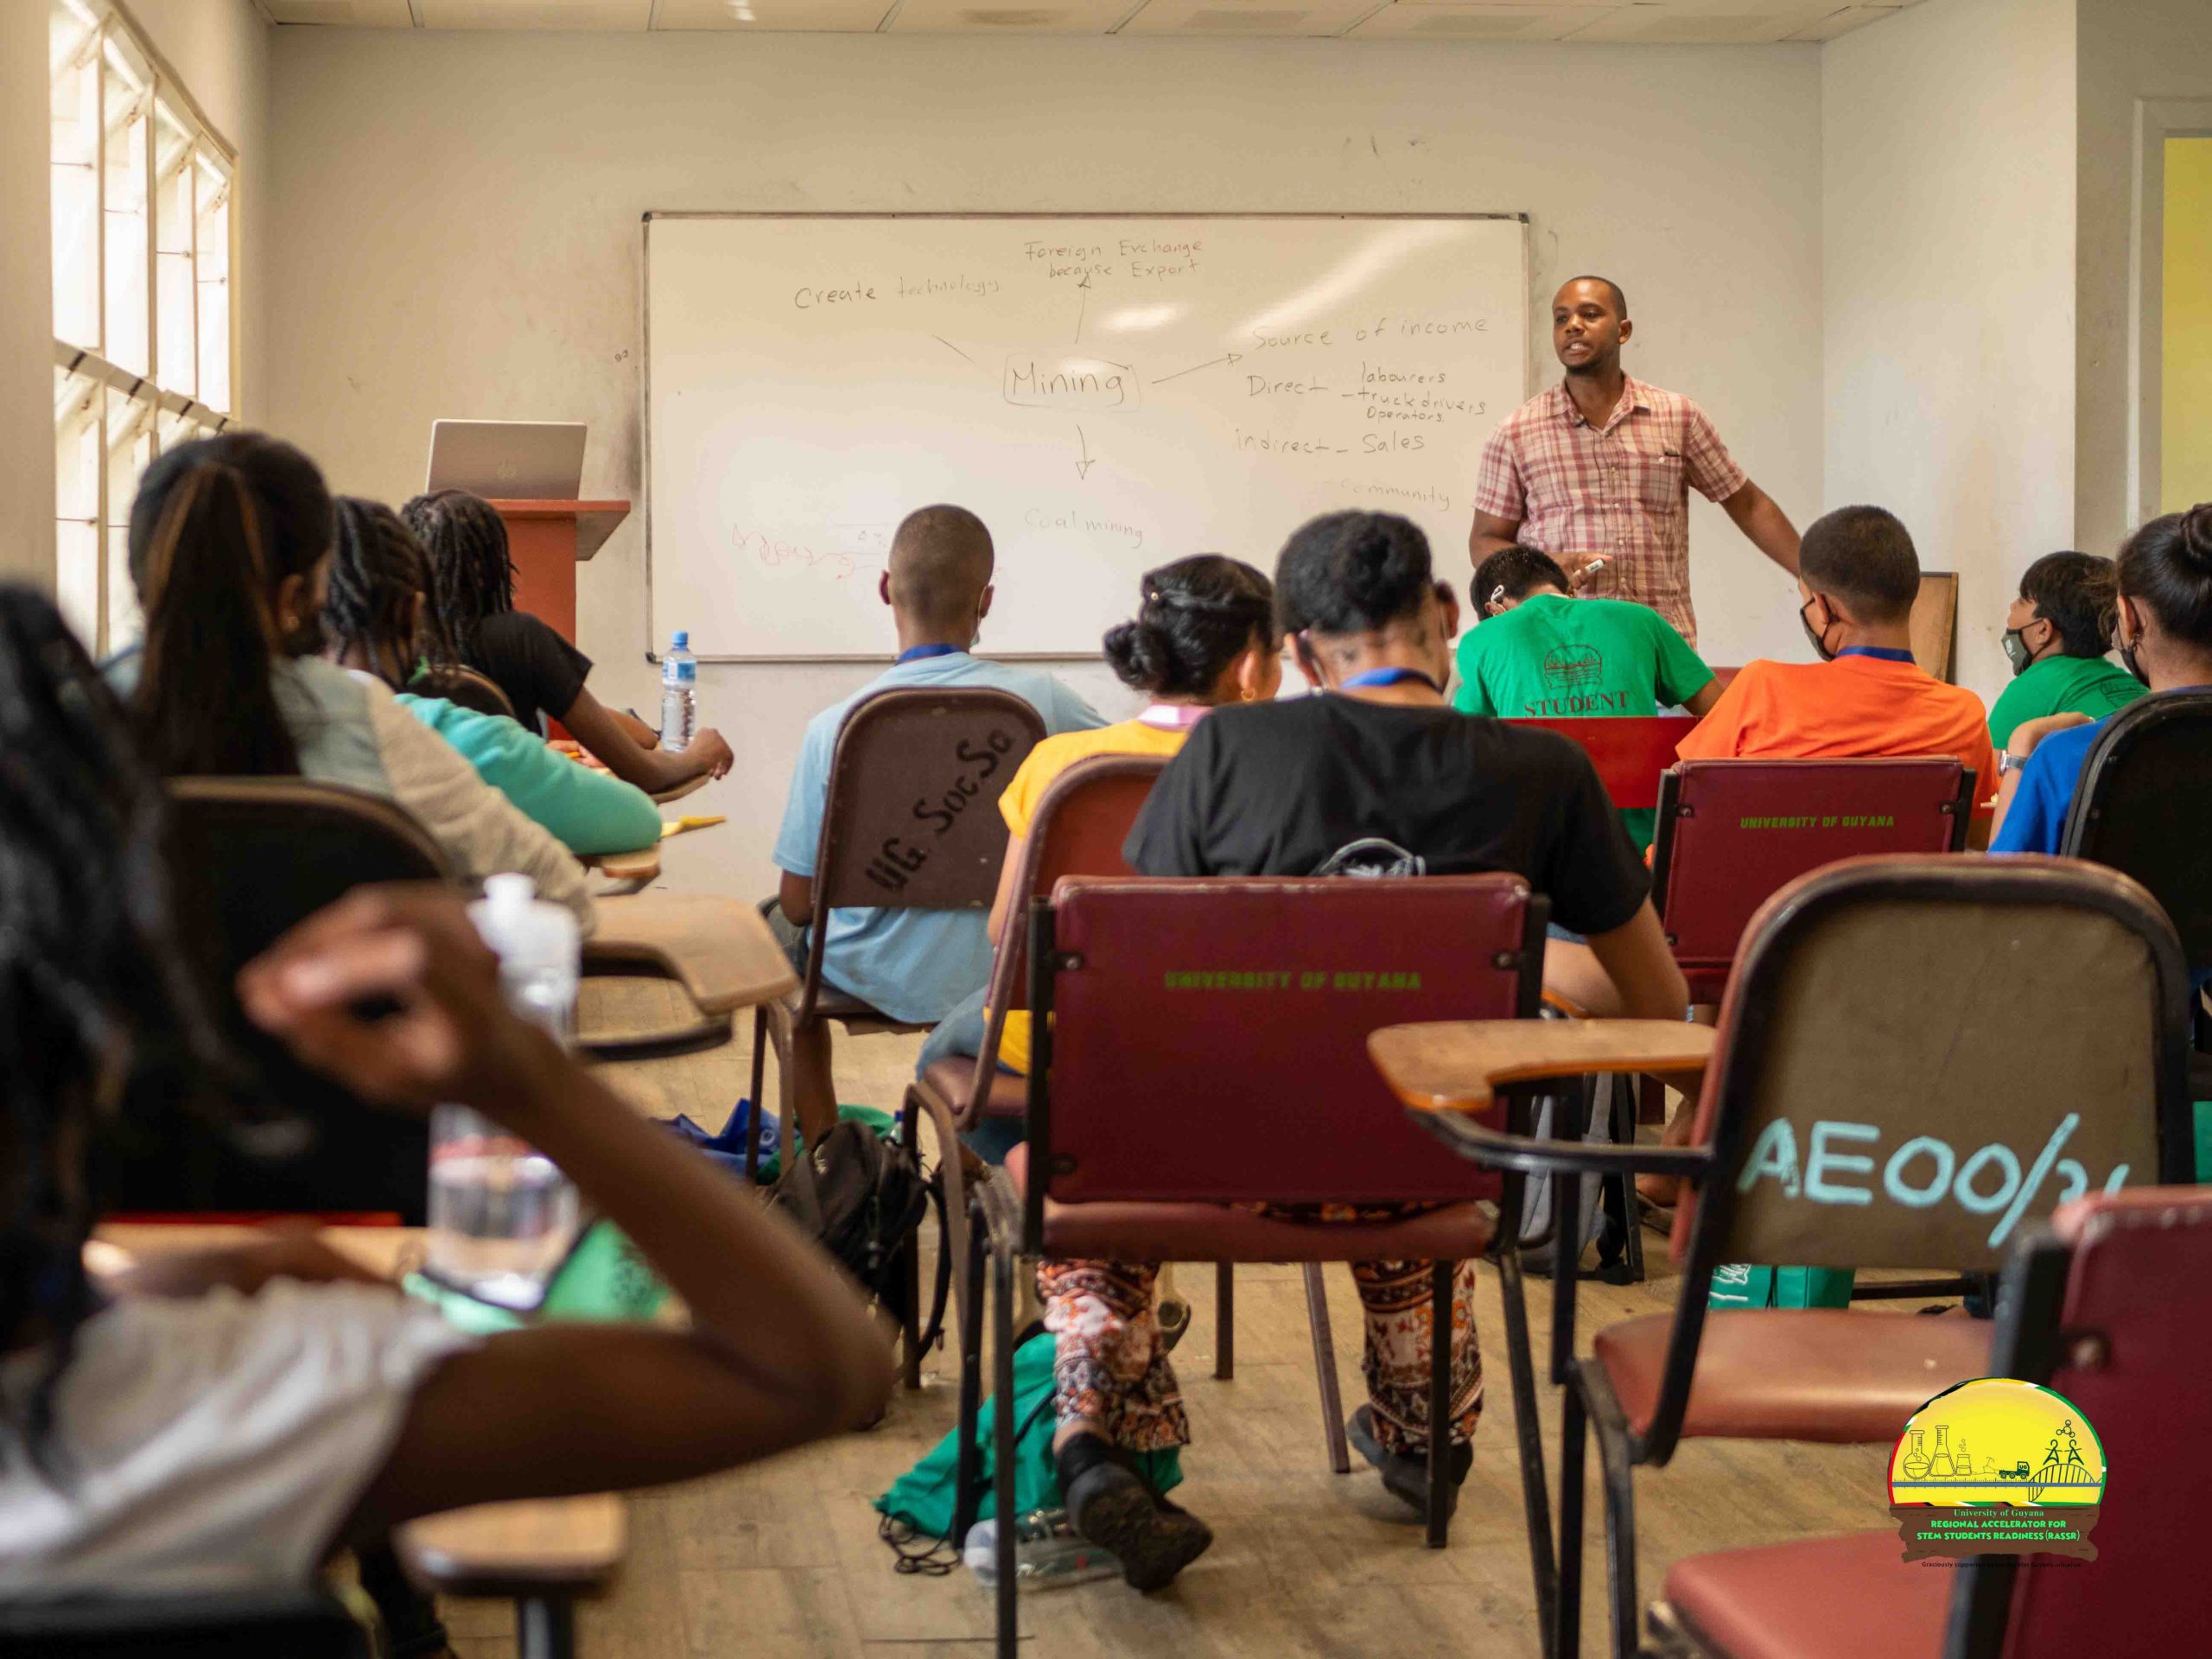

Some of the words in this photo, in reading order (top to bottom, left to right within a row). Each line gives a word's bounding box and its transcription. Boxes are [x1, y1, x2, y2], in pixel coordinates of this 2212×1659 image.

[1024, 240, 1102, 260] Foreign
[1048, 263, 1113, 279] because
[1131, 258, 1201, 282] Export
[794, 282, 877, 309] Create
[1252, 326, 1333, 350] Source
[1355, 317, 1387, 342] of
[1401, 318, 1490, 334] income
[1012, 361, 1125, 408] Mining
[1246, 375, 1329, 397] Direct
[1362, 430, 1425, 454] Sales
[1524, 690, 1630, 718] STUDENT
[1740, 817, 1816, 829] UNIVERSITY
[1822, 816, 1839, 828] OF
[1842, 816, 1895, 827] GUYANA
[1165, 971, 1292, 988] UNIVERSITY
[1301, 971, 1326, 988] OF
[1333, 971, 1422, 988] GUYANA
